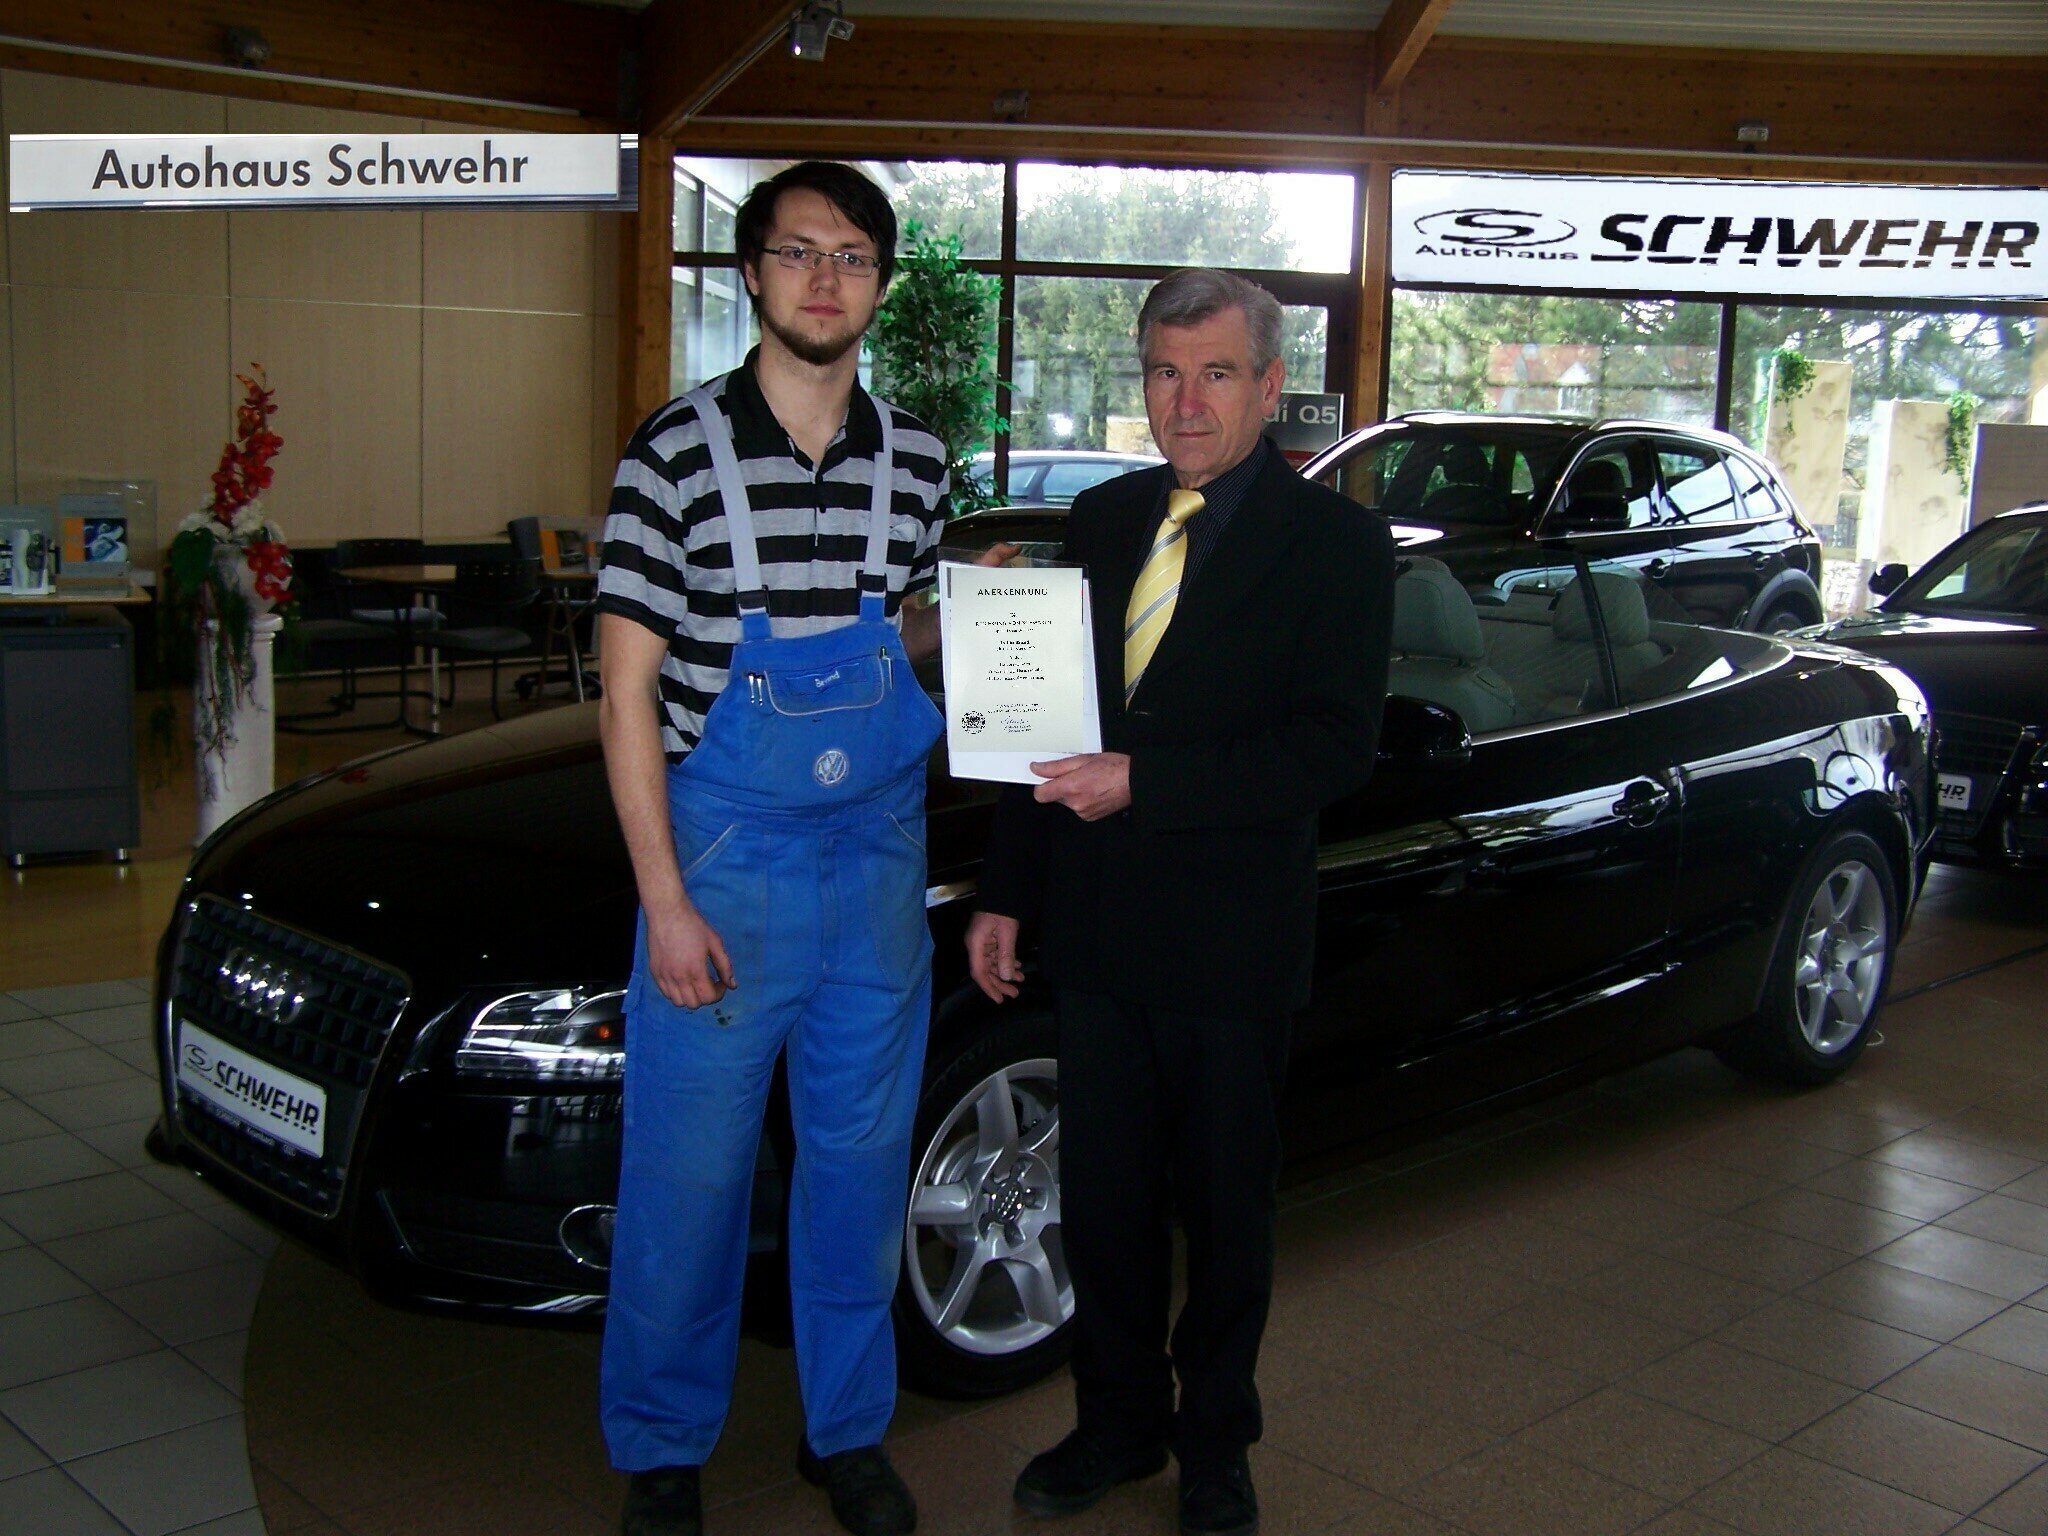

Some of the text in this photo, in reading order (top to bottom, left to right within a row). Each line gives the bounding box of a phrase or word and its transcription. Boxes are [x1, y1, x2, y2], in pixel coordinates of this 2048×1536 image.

[92, 140, 529, 190] Autohaus Schwehr
[1415, 244, 1579, 261] Autohaus
[1590, 213, 2040, 269] SCHWEHR
[1299, 404, 1338, 425] Q5
[213, 1060, 320, 1135] SCHWEHR
